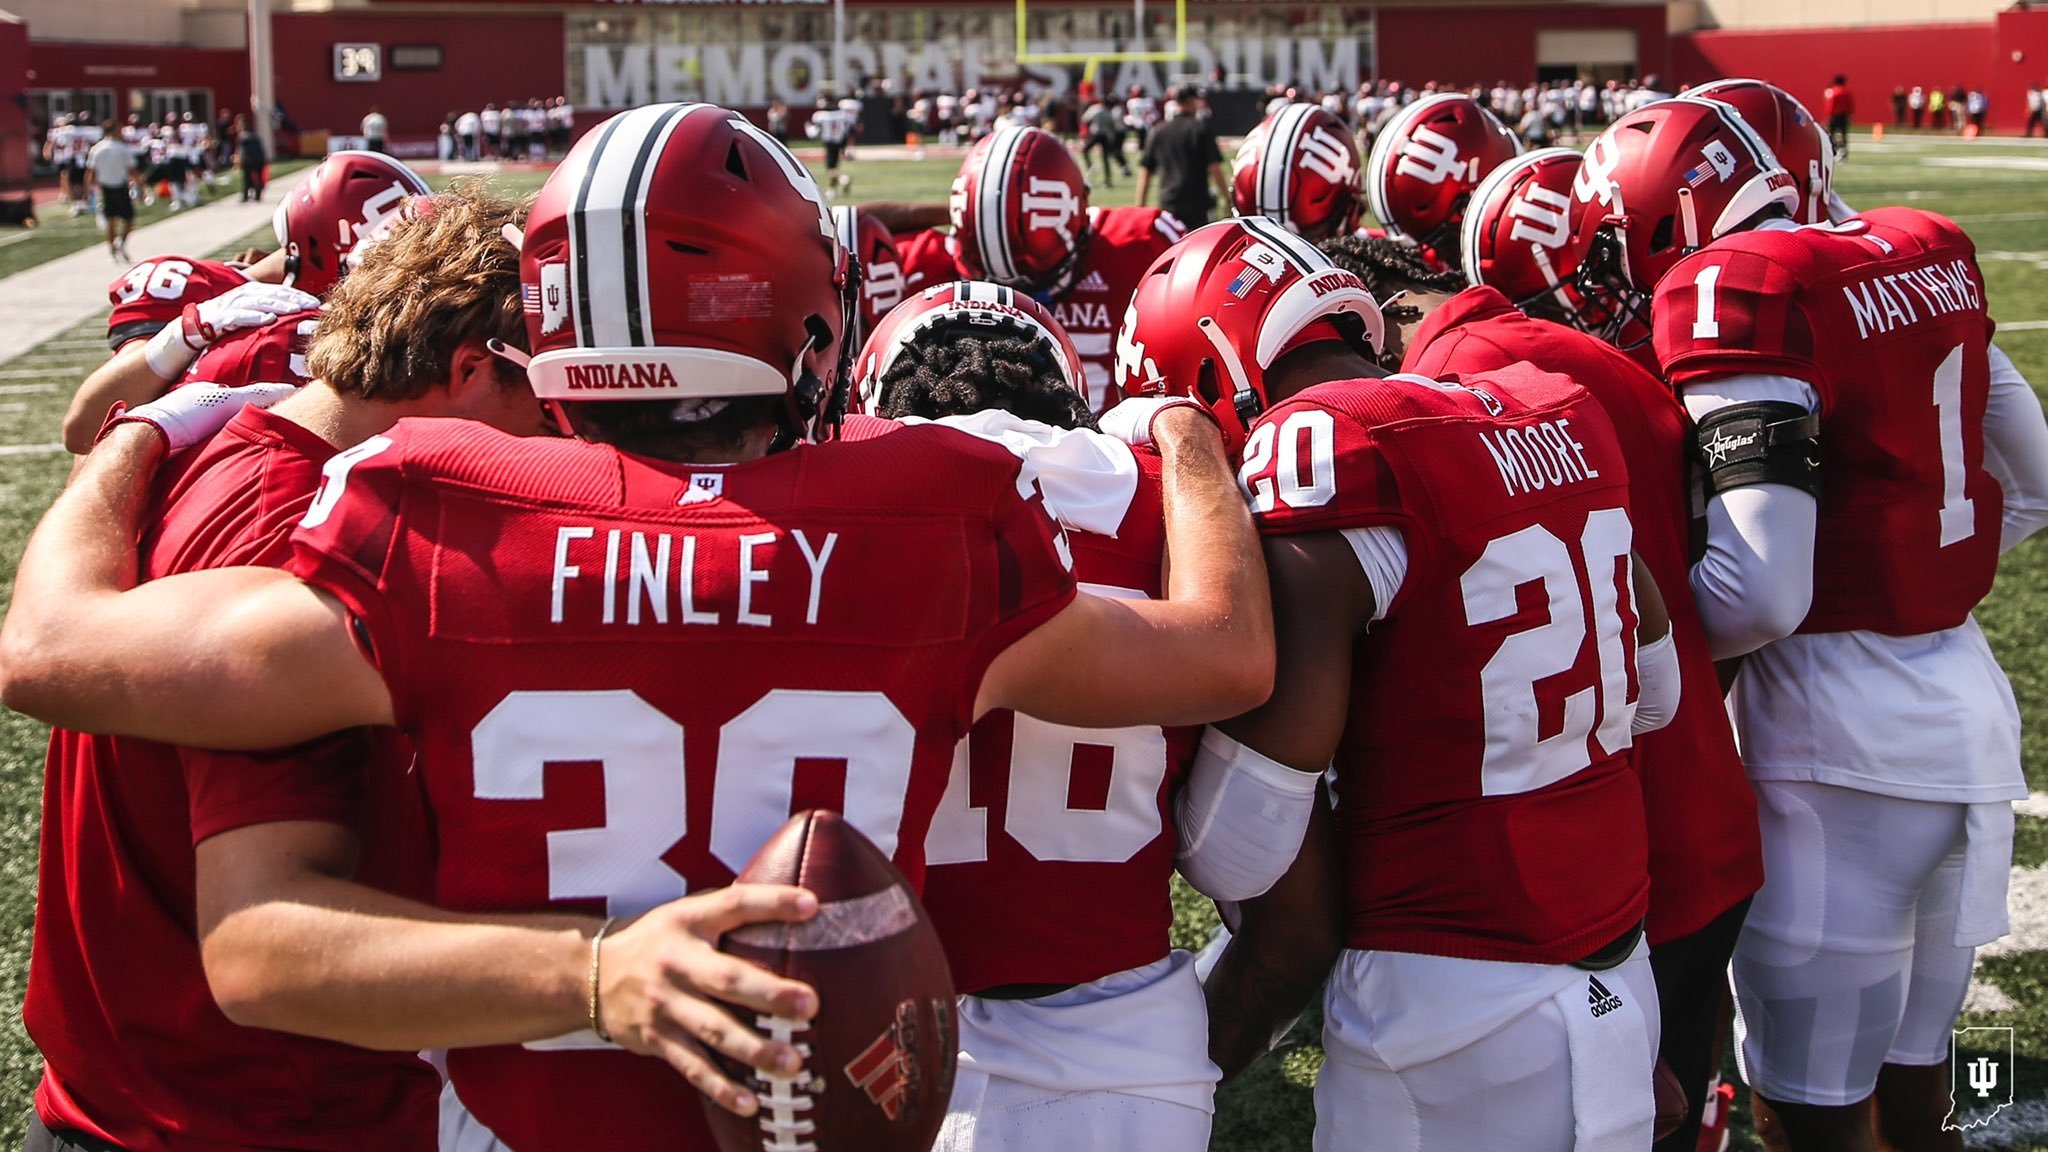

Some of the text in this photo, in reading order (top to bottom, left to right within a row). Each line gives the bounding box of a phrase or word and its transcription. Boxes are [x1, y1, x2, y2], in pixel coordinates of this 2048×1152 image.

[1020, 38, 1360, 100] STADIUM
[949, 299, 1026, 321] INDIANA
[1691, 265, 1722, 340] 1
[1842, 259, 1980, 340] MATTHEWS
[564, 362, 678, 390] INDIANA
[1237, 409, 1337, 514] 20
[1478, 418, 1600, 498] MOORE
[1713, 432, 1755, 455] Douglas
[1932, 342, 1976, 549] 1
[550, 526, 839, 626] FINLEY
[1460, 507, 1639, 797] 20
[1590, 995, 1624, 1018] adidas
